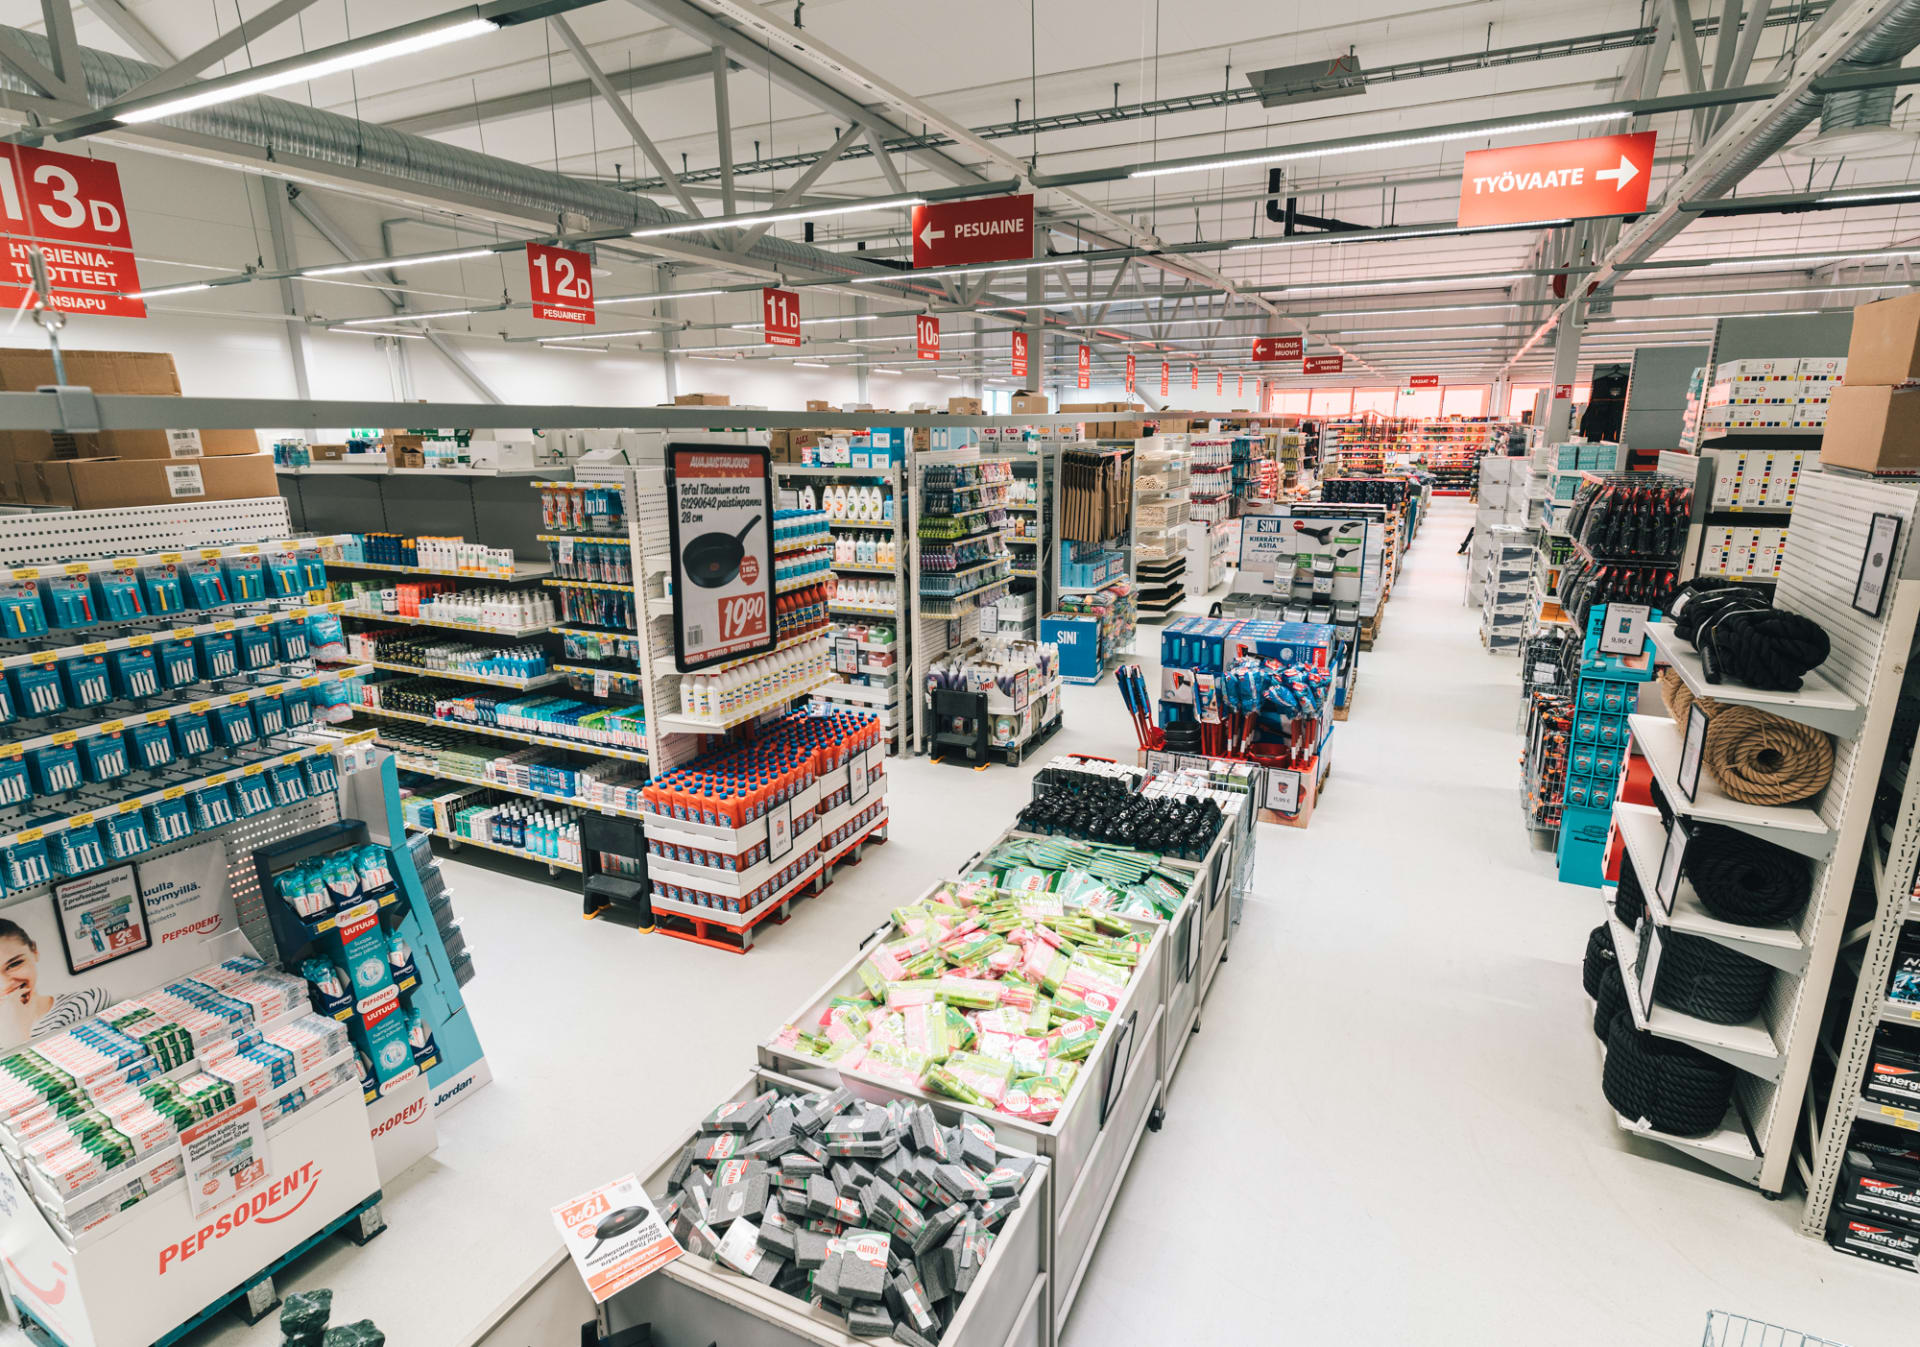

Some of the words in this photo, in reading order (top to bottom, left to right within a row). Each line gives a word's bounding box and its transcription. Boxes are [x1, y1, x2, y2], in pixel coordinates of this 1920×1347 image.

[1473, 168, 1584, 195] TYÖVAATE
[954, 218, 1024, 238] PESUAINE
[533, 253, 591, 300] 12D
[47, 295, 107, 311] NSIAPU
[767, 295, 798, 328] 11D
[543, 308, 586, 321] PESUAINEET
[918, 320, 939, 345] 10D
[681, 483, 699, 495] Tefal
[700, 483, 731, 495] Titanium
[732, 485, 750, 494] extra
[717, 496, 762, 510] paistinpannu
[681, 511, 691, 523] 28
[692, 514, 703, 522] cm
[1259, 520, 1278, 533] SINI
[1057, 630, 1077, 645] SINI
[980, 681, 994, 692] OMO
[144, 882, 174, 897] uulla
[146, 882, 201, 907] hymyillä.
[162, 914, 220, 944] PEPSODENT
[343, 919, 376, 936] UUTUUS
[366, 1001, 398, 1021] UUTUUS
[434, 1077, 473, 1107] Jordan
[370, 1096, 425, 1141] PSODENT
[159, 1160, 314, 1275] PEPSODENT
[857, 1244, 879, 1256] FAIRY
